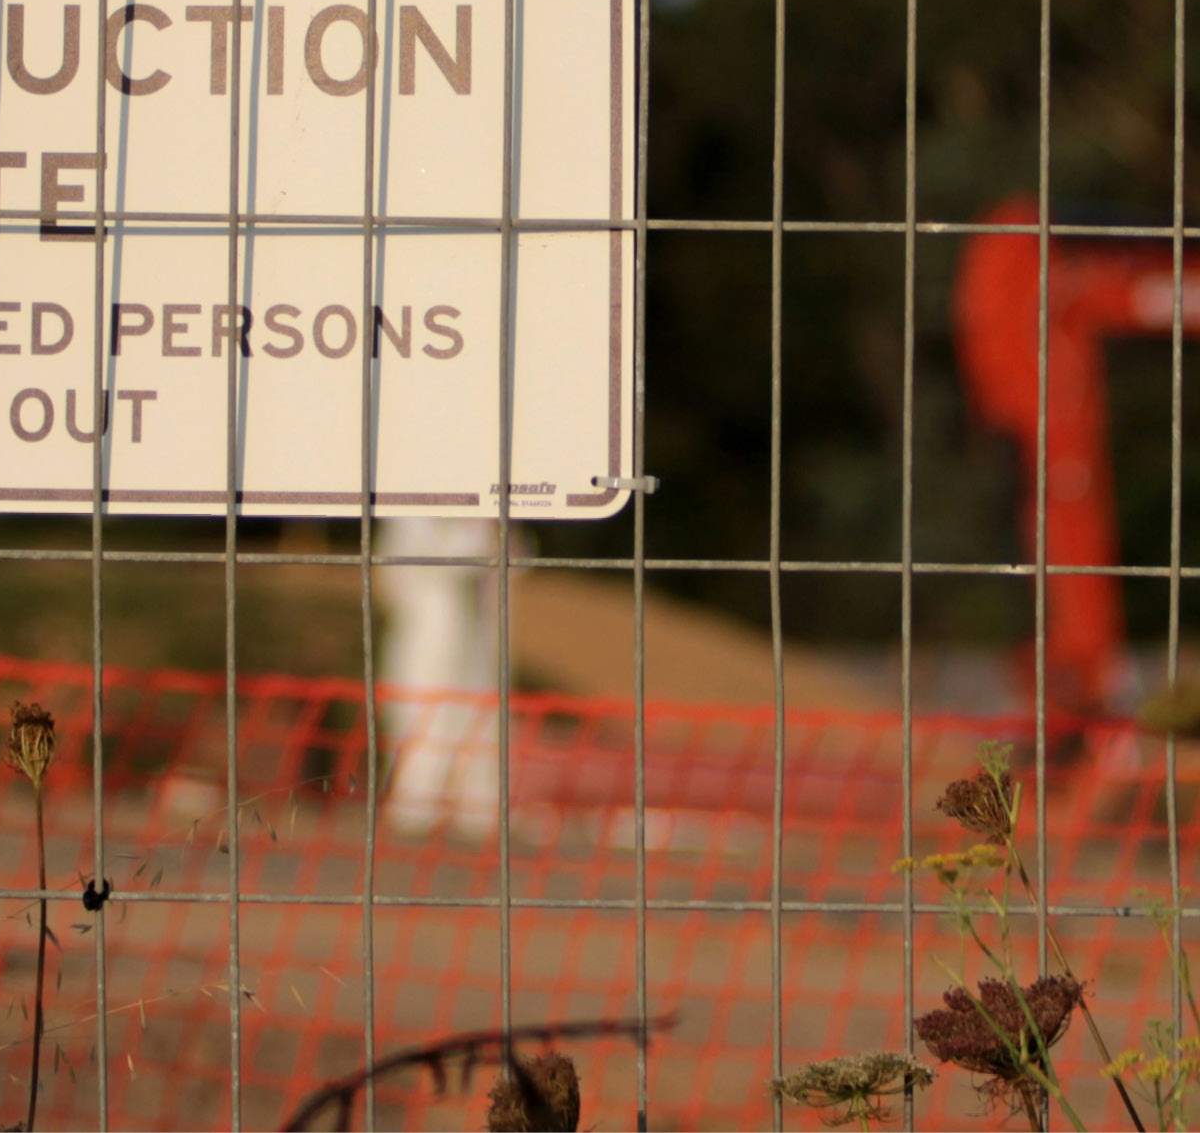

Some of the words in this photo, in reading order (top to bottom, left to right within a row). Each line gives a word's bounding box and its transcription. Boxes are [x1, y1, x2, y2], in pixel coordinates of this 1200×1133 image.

[111, 303, 464, 359] PERSONS
[8, 388, 157, 443] OUT
[489, 481, 556, 494] posafe
